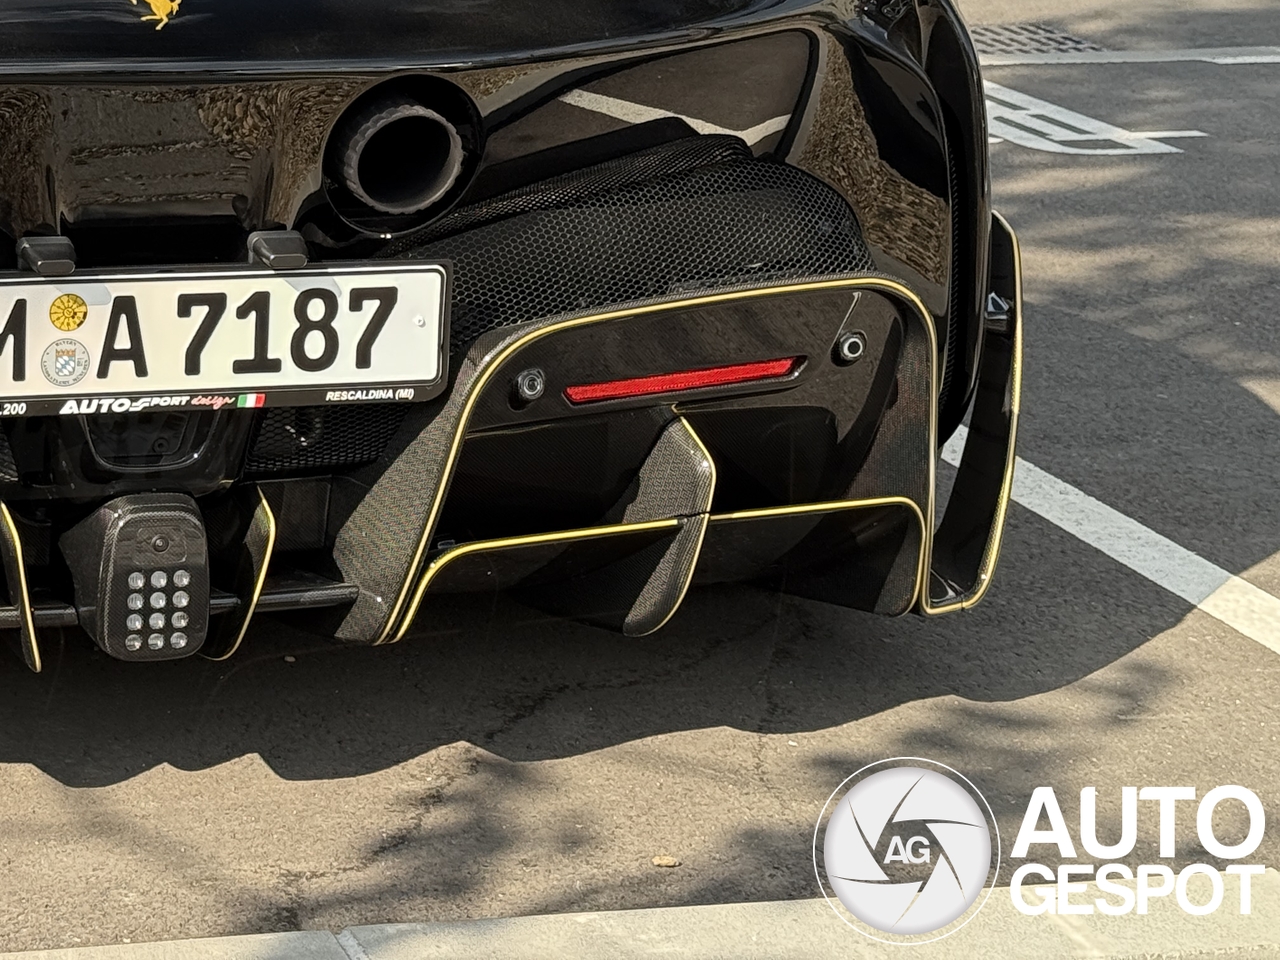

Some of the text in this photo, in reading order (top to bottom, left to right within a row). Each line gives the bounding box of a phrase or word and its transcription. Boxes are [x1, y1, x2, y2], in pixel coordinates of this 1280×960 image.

[96, 295, 149, 379] A
[177, 286, 399, 376] 7187
[190, 394, 235, 410] design
[325, 388, 415, 402] RESCALDINA (MI)
